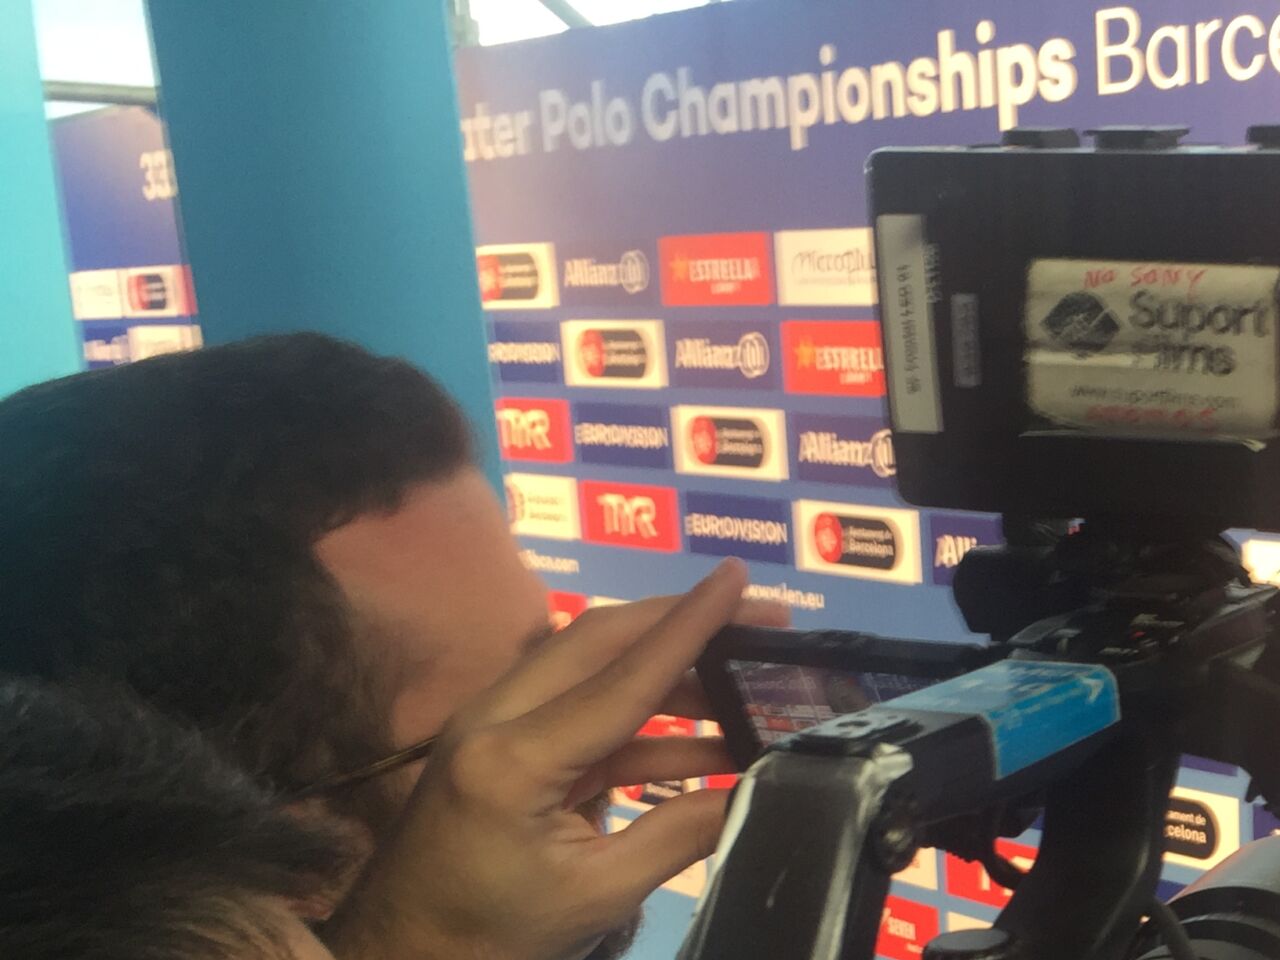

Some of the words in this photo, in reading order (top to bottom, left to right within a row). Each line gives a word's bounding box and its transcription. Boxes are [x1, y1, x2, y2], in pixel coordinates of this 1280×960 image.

[539, 79, 632, 153] Polo
[640, 19, 1077, 150] Championships
[596, 493, 658, 538] TYR
